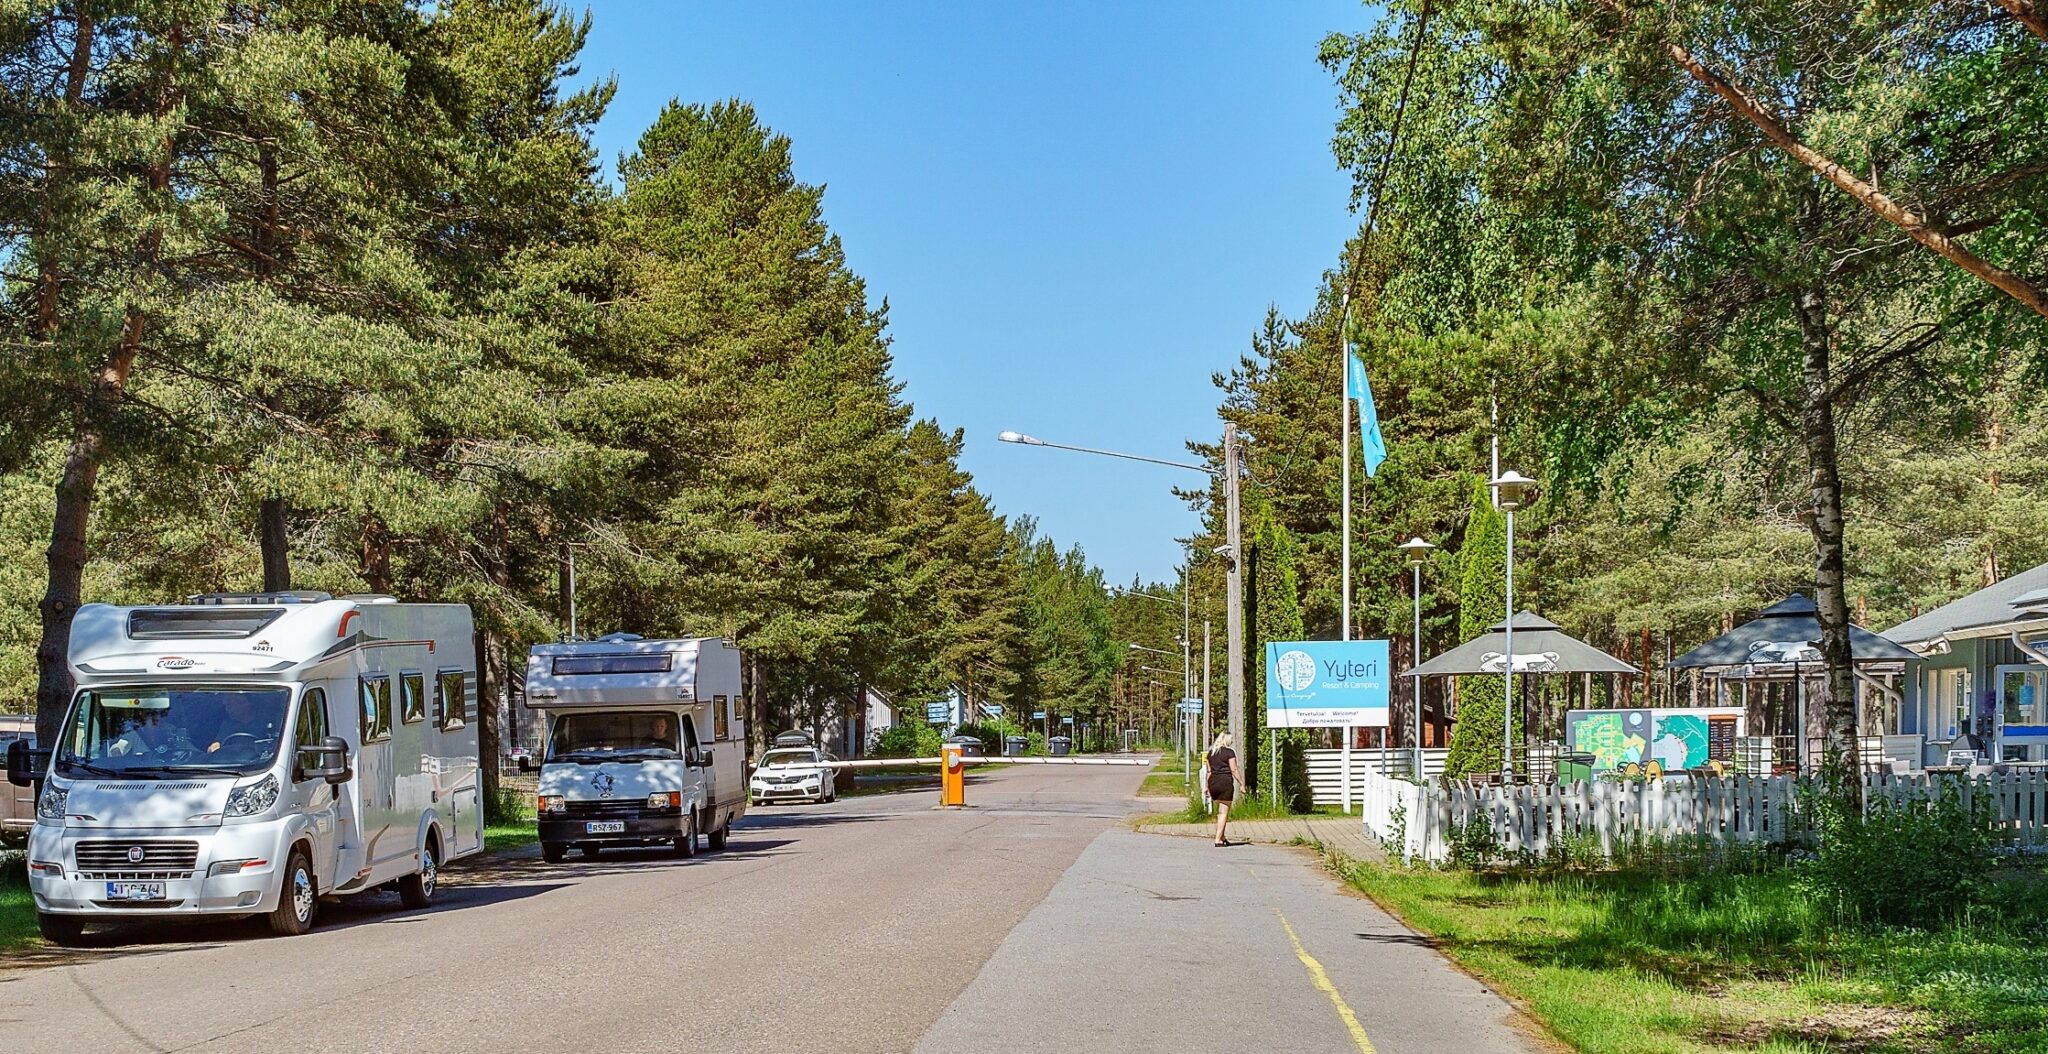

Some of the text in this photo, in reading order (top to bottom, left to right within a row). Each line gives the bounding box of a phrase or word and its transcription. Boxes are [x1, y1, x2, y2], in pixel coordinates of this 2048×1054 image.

[157, 659, 194, 668] Carado
[1323, 660, 1377, 681] Yyteri
[1350, 682, 1380, 690] Camping
